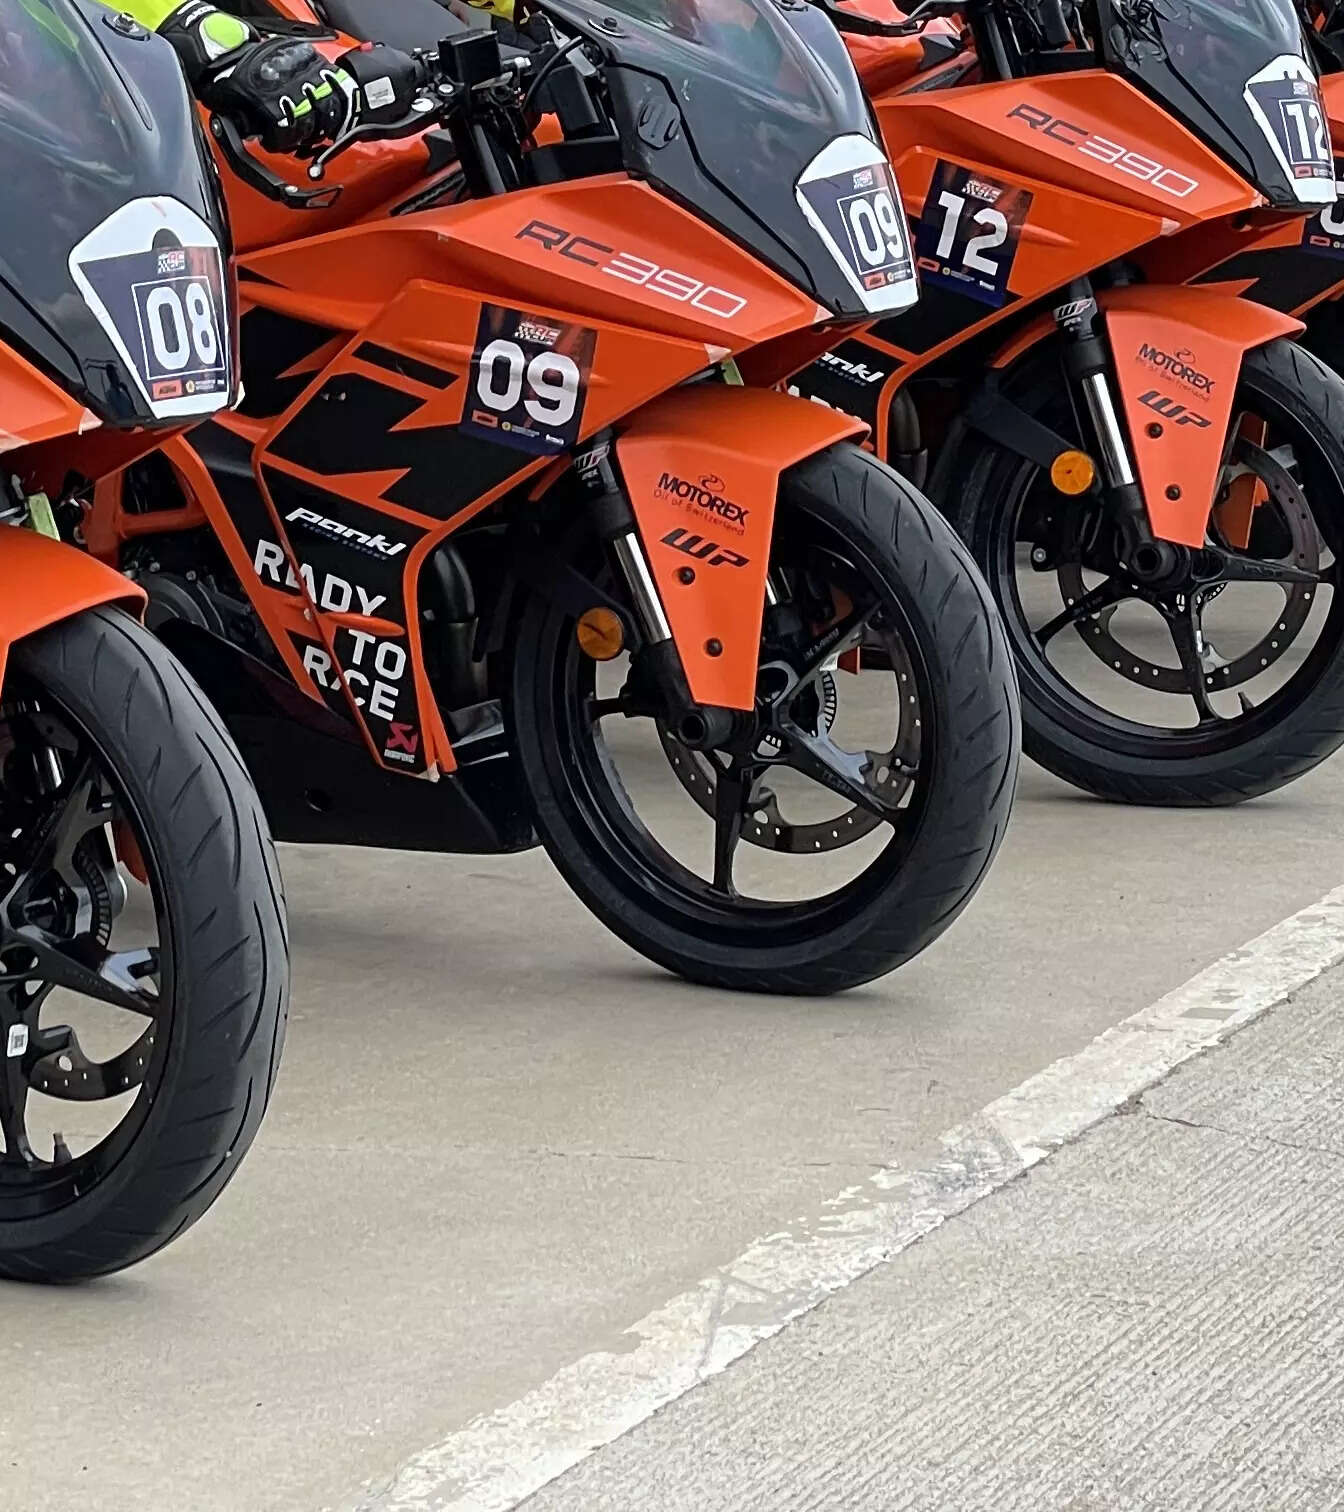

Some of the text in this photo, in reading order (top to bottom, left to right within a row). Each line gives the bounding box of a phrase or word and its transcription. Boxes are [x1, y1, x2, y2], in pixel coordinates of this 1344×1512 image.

[1286, 103, 1329, 161] 12
[849, 192, 905, 266] 09
[935, 189, 1008, 277] 12
[146, 283, 217, 370] 08
[477, 339, 580, 426] 09
[1138, 343, 1216, 394] MOTOREX
[658, 472, 749, 527] MOTOREX
[303, 645, 400, 722] RCE
[348, 628, 407, 681] TO
